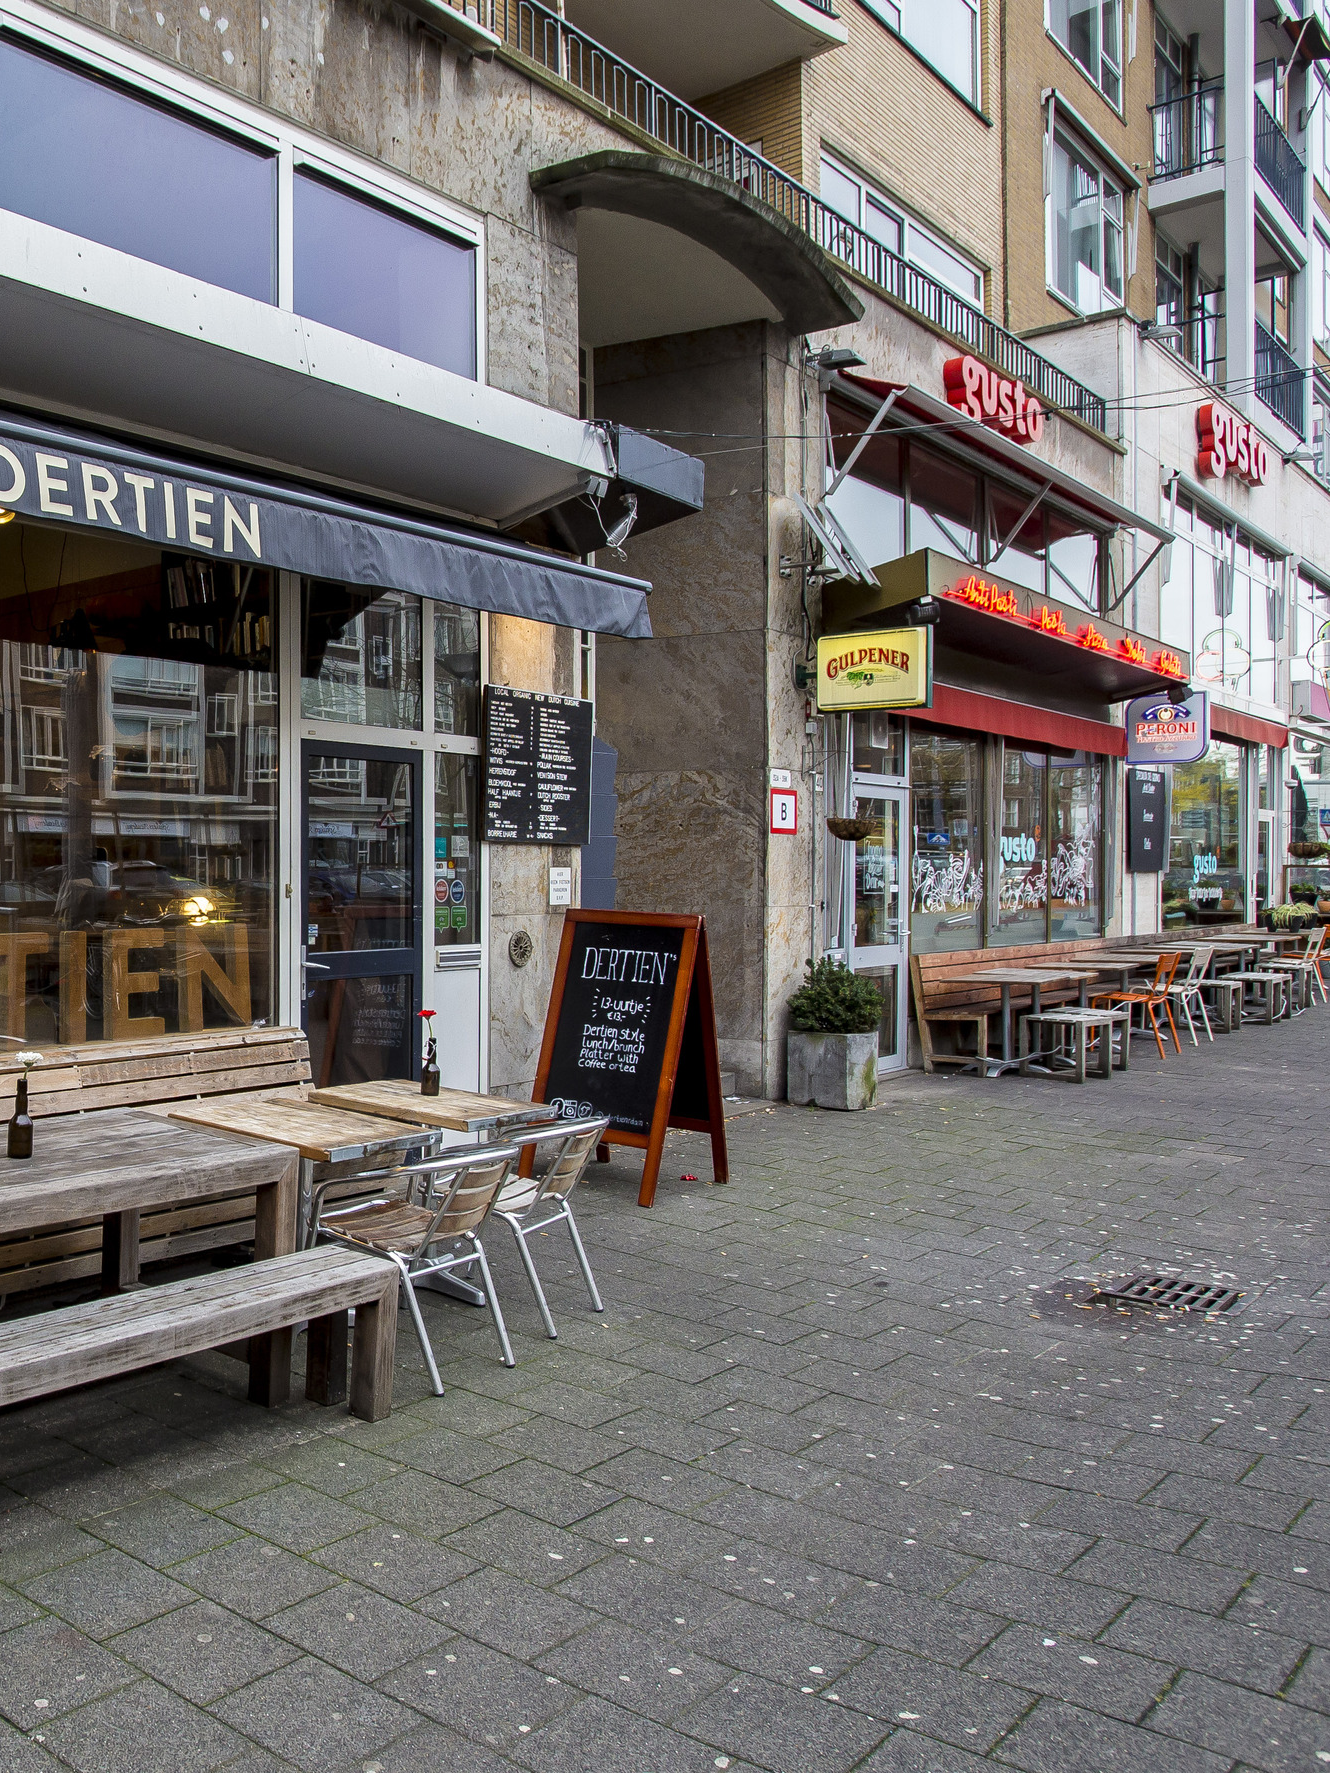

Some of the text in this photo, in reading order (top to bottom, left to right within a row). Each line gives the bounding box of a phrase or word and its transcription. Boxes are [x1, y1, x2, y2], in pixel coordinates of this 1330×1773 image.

[960, 354, 1044, 443] gusto
[1210, 402, 1270, 488] gusto
[826, 647, 910, 680] GULPENER
[494, 688, 580, 708] LOCAL ORGANIC NEW DUTCH CUISINE
[1136, 721, 1197, 736] PERONI
[781, 802, 788, 821] B
[1193, 852, 1218, 884] gusto
[583, 1024, 645, 1043] Dertien style
[617, 1053, 639, 1065] with
[619, 1063, 636, 1074] tea
